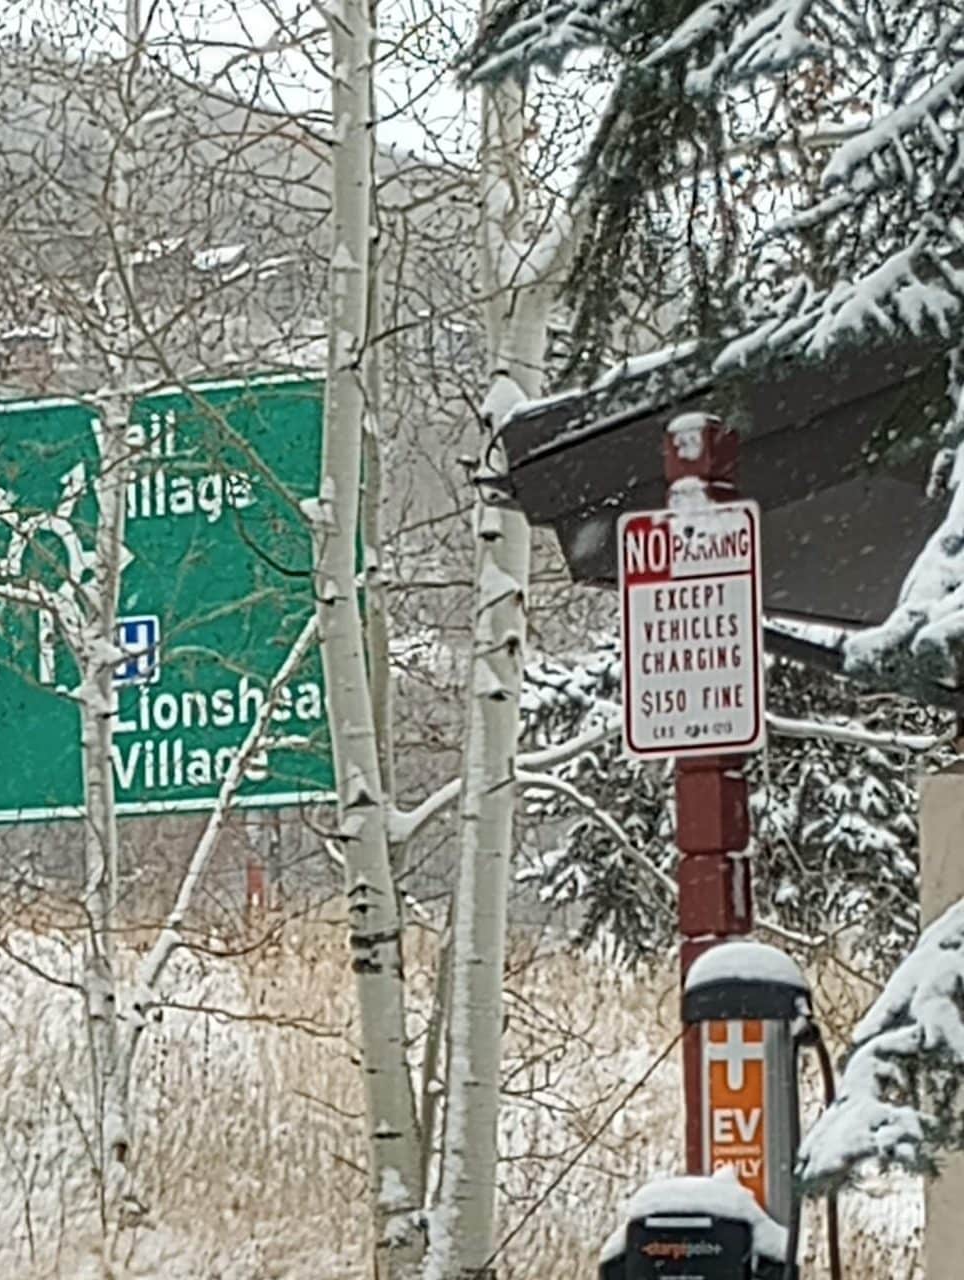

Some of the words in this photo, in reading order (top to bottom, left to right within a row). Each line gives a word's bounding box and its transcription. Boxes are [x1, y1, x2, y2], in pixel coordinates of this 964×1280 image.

[626, 528, 667, 575] NO
[654, 584, 726, 612] EXCEPT
[644, 614, 739, 643] VEHICLES
[642, 645, 742, 675] CHARGING
[112, 674, 329, 733] Lionshea
[641, 689, 686, 717] $150
[702, 684, 744, 710] FINE
[111, 737, 269, 790] Village
[713, 1108, 762, 1142] EV
